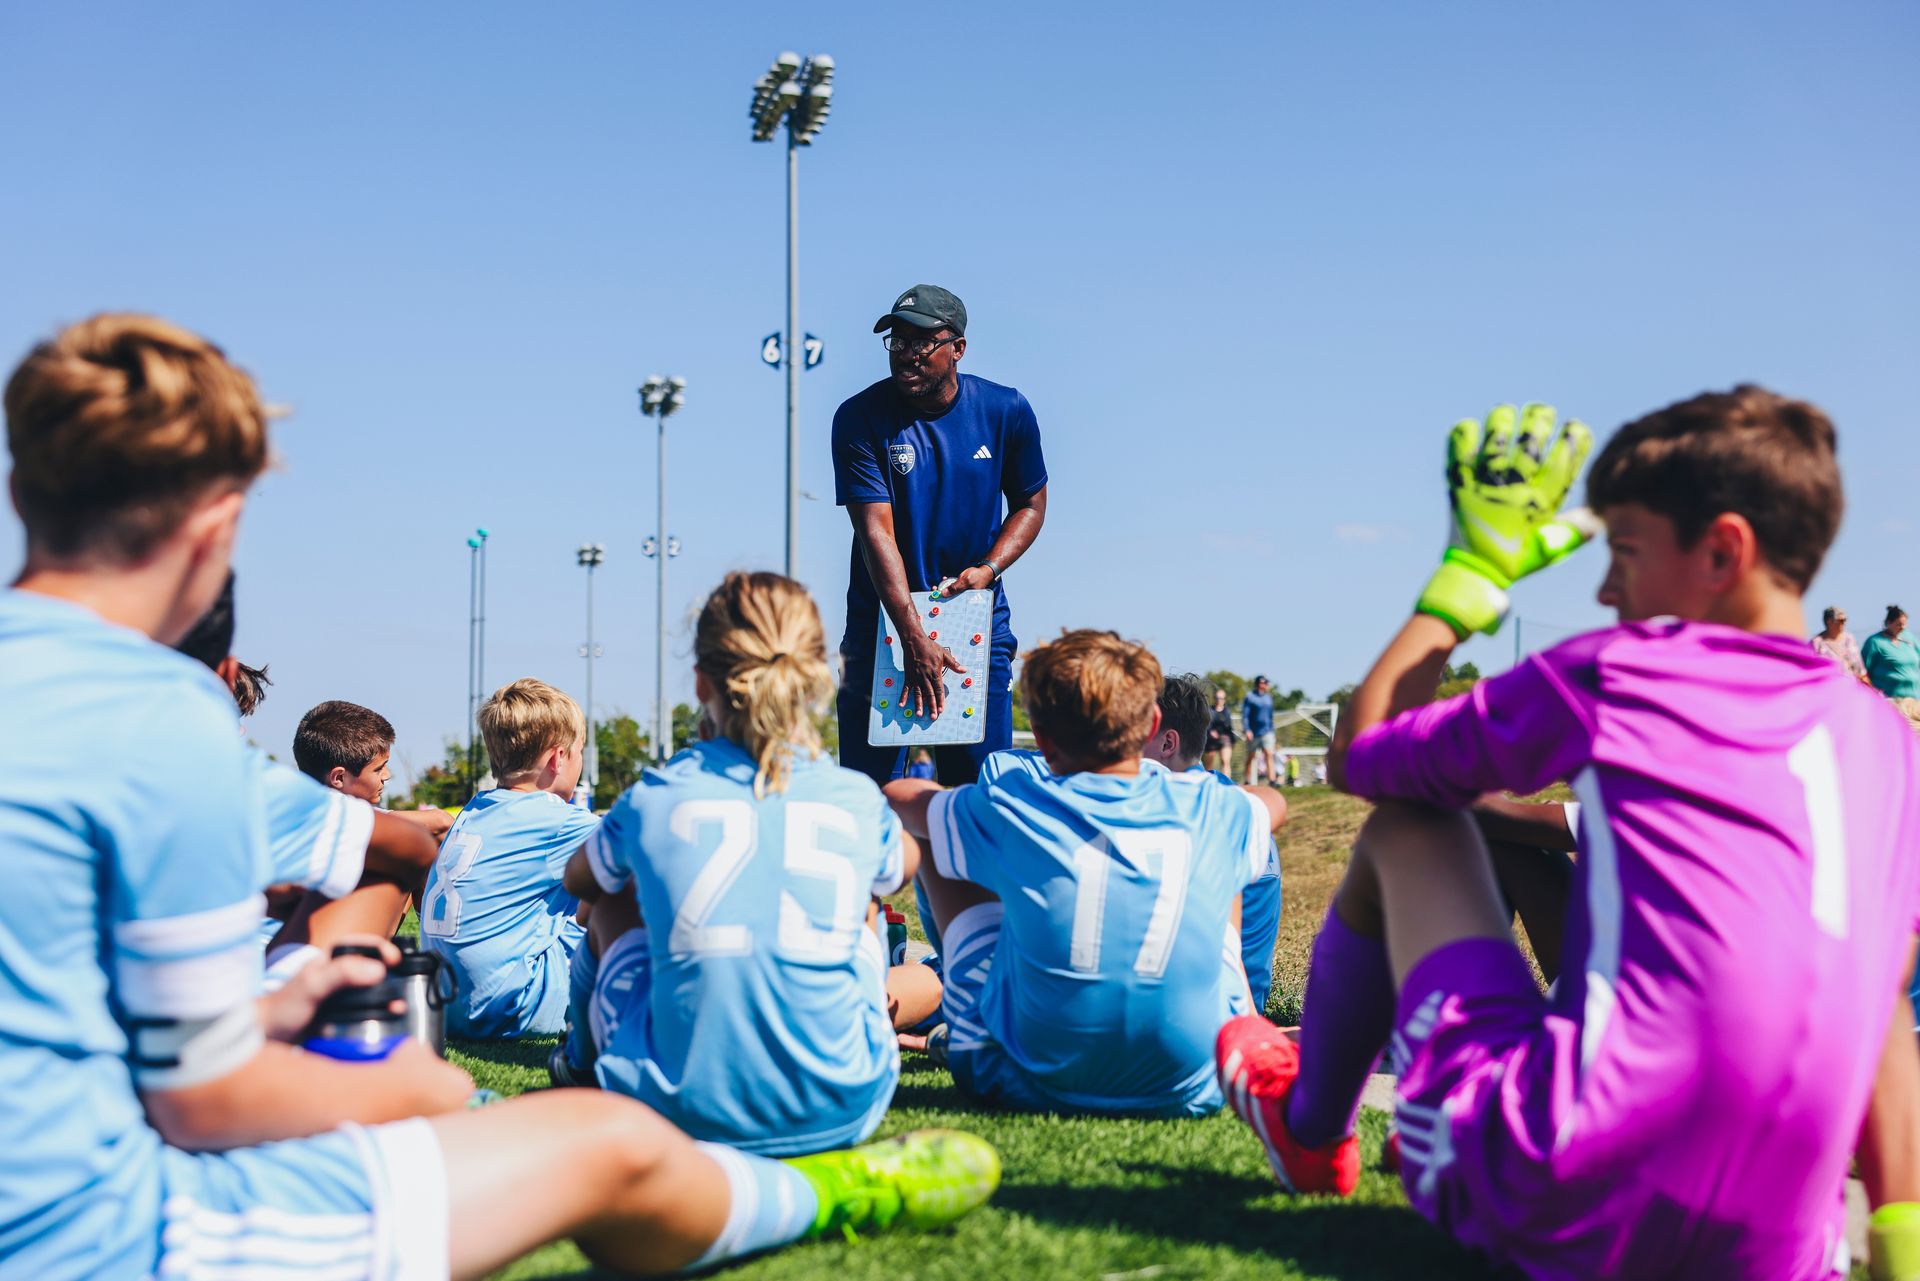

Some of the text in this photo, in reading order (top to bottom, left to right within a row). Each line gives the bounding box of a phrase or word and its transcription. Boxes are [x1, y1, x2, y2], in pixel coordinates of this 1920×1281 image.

[763, 336, 780, 363] 6
[804, 338, 824, 365] 7
[424, 831, 483, 938] 8
[669, 799, 859, 961] 25
[1787, 722, 1848, 941] 1
[1069, 828, 1192, 978] 17
